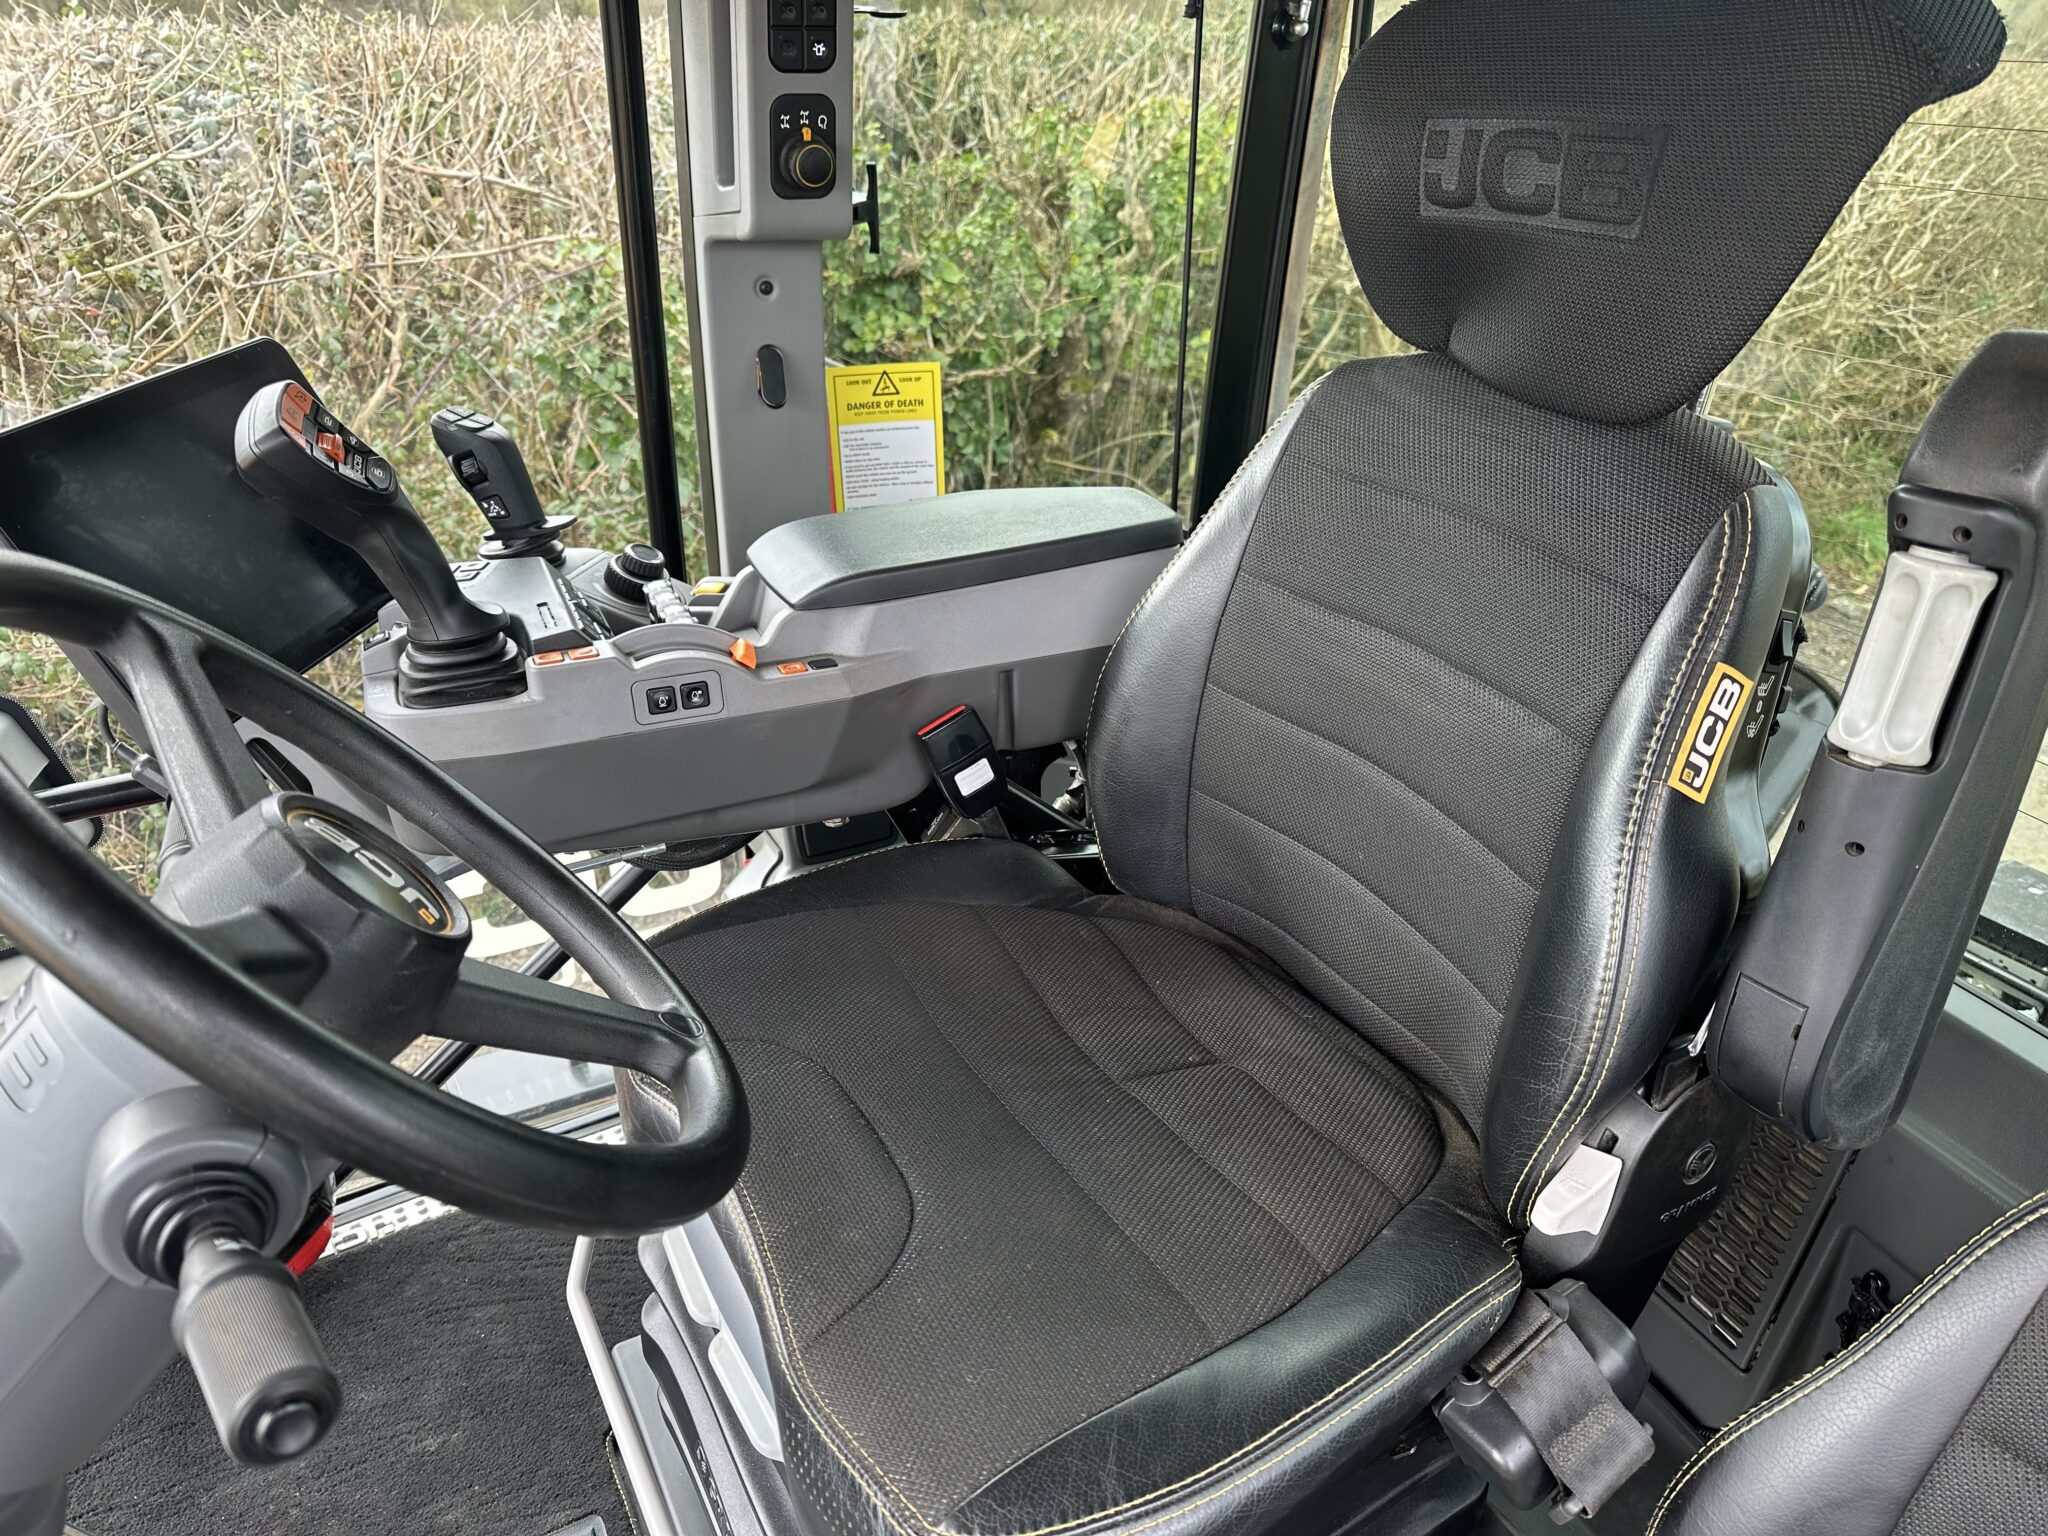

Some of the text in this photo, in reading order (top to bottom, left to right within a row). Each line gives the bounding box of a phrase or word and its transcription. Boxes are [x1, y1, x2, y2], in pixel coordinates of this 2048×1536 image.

[1420, 119, 1668, 239] JCB
[847, 398, 924, 411] DANGER OF DEATH
[1687, 676, 1742, 789] JCB
[303, 816, 441, 921] JCB
